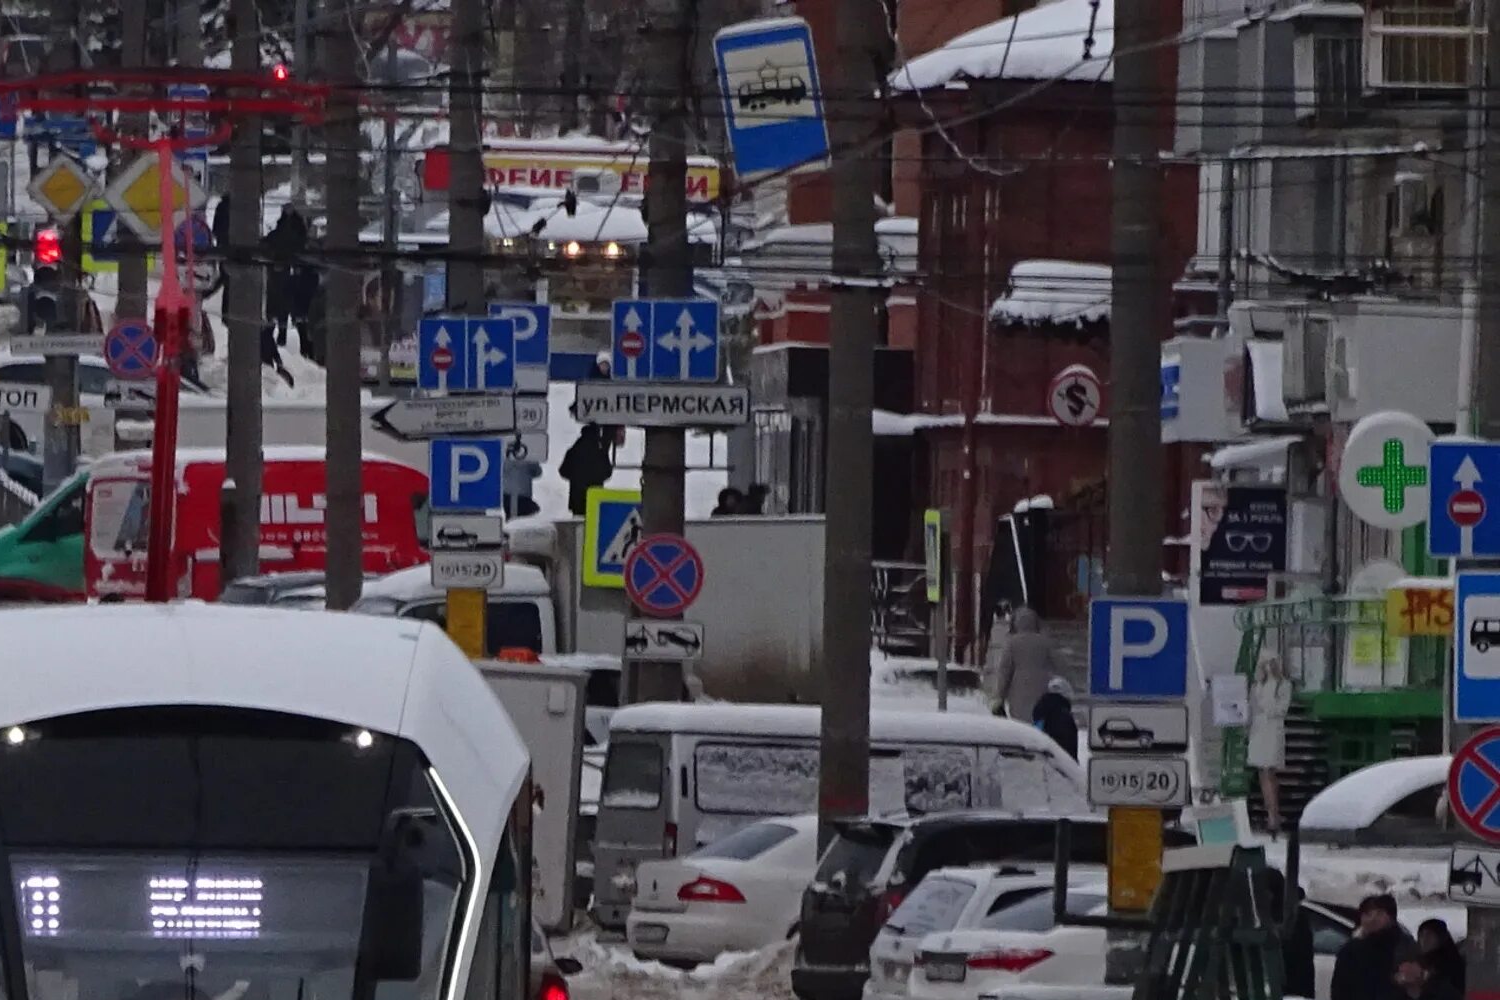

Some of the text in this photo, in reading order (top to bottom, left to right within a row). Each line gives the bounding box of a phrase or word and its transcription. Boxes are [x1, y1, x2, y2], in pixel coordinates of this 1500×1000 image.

[451, 443, 489, 502] P
[1109, 606, 1168, 690] P
[1147, 772, 1170, 791] 20
